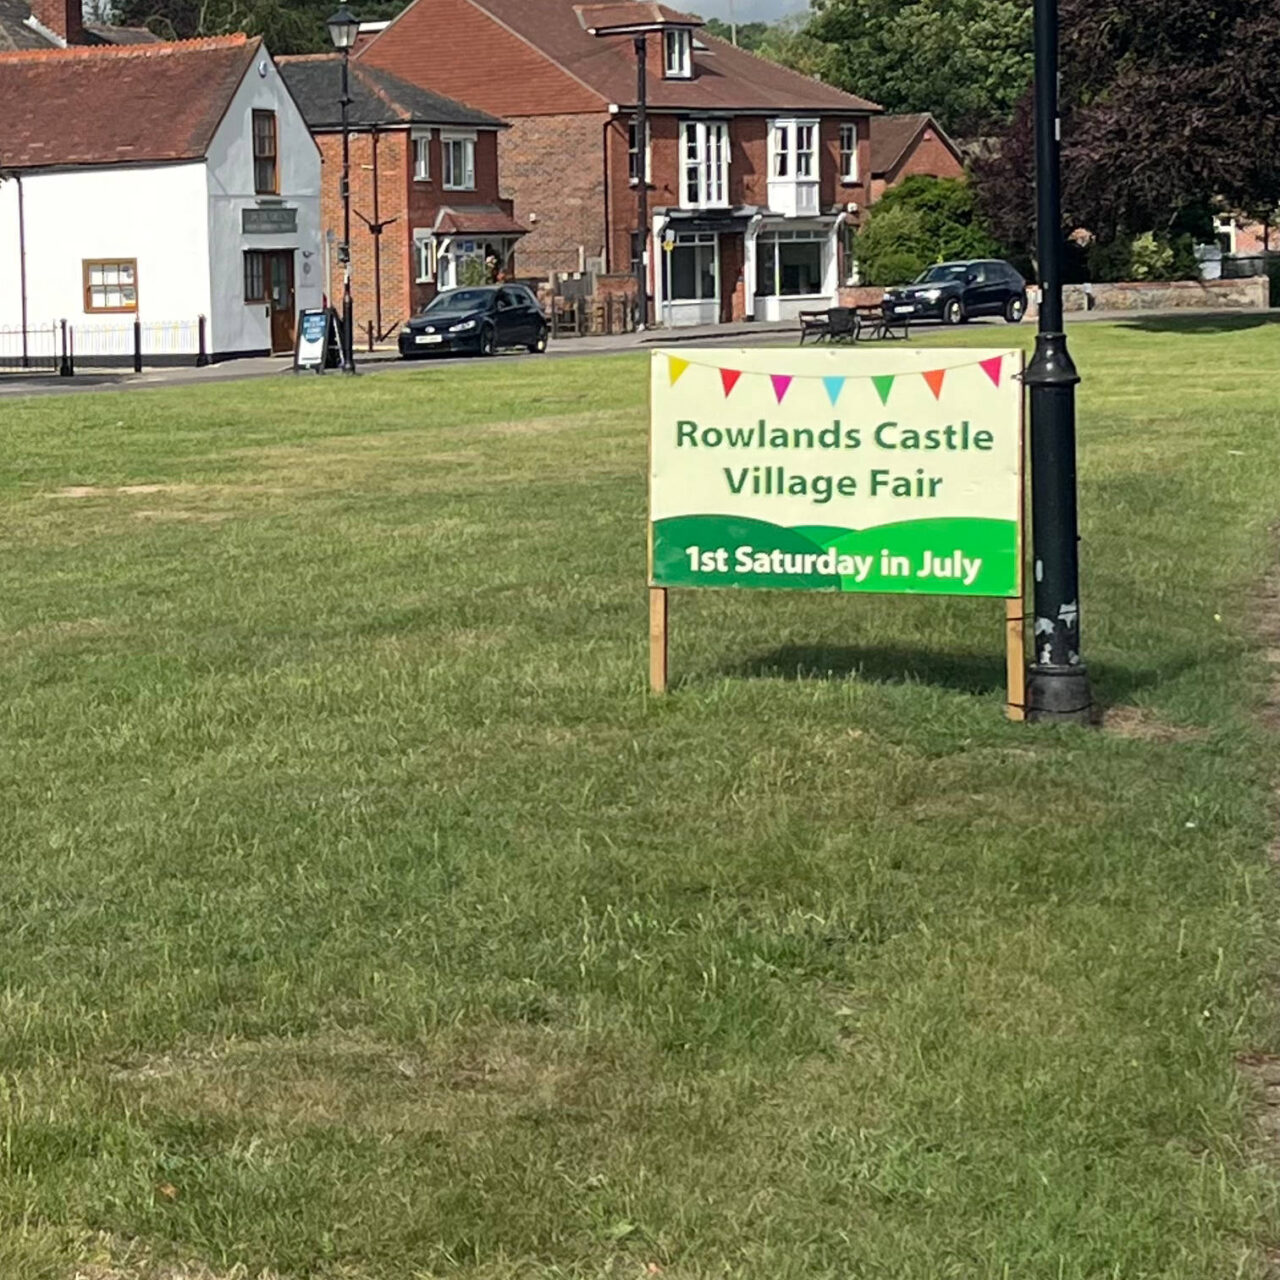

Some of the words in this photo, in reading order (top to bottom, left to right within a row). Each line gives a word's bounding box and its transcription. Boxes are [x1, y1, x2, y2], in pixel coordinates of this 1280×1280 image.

[676, 419, 862, 449] Rowlands
[874, 421, 994, 450] Castle
[723, 467, 857, 503] Village
[870, 469, 943, 497] Fair
[685, 546, 729, 572] 1st
[735, 546, 873, 583] Saturday
[881, 549, 910, 577] in
[916, 550, 982, 585] July
